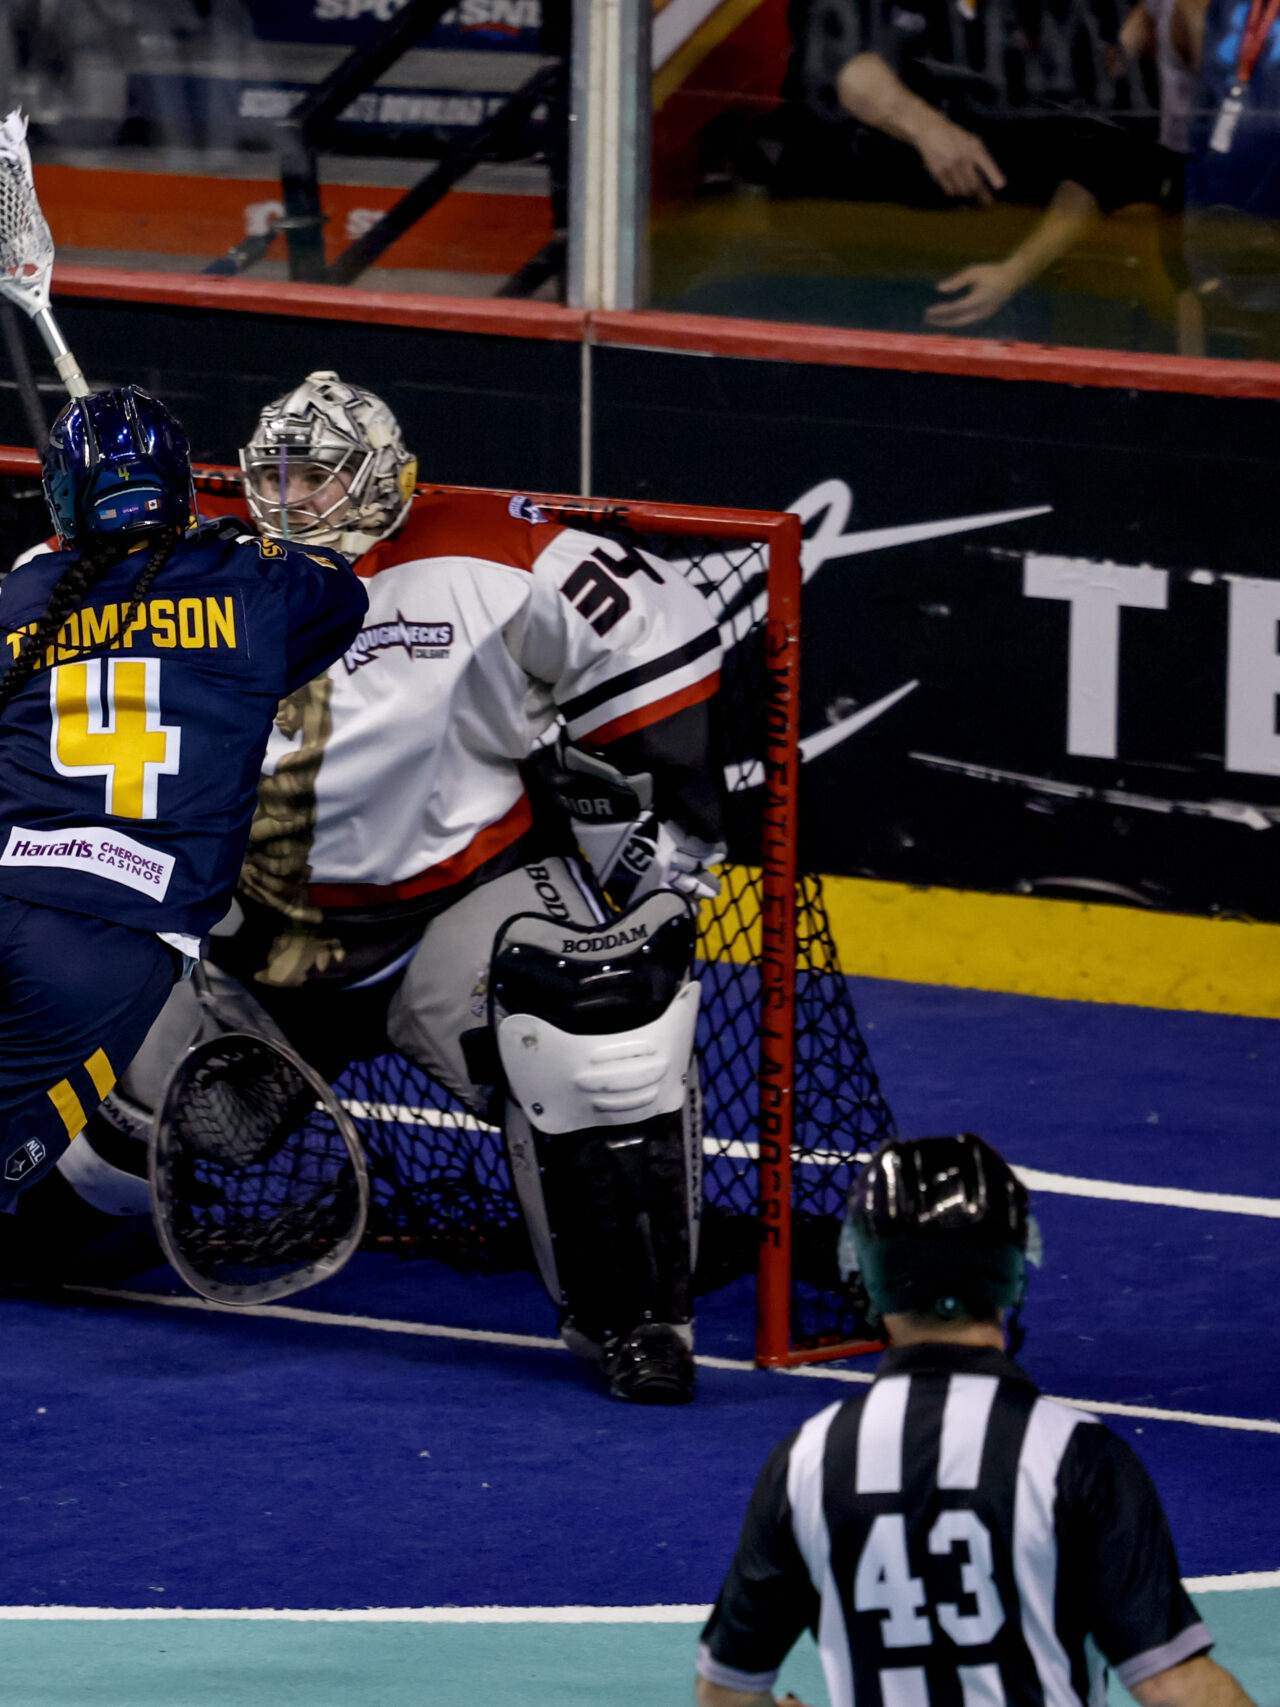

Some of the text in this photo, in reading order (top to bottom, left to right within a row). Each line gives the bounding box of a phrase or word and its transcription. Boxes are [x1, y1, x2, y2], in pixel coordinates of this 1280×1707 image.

[118, 467, 130, 481] 4
[559, 546, 666, 638] 34
[50, 657, 181, 819] 4
[11, 839, 94, 858] Harrah's
[100, 842, 164, 875] CHEROKEE
[97, 853, 161, 885] CASINOS
[561, 924, 649, 954] BODDAM
[26, 1139, 44, 1162] NLL
[854, 1510, 1006, 1648] 43
